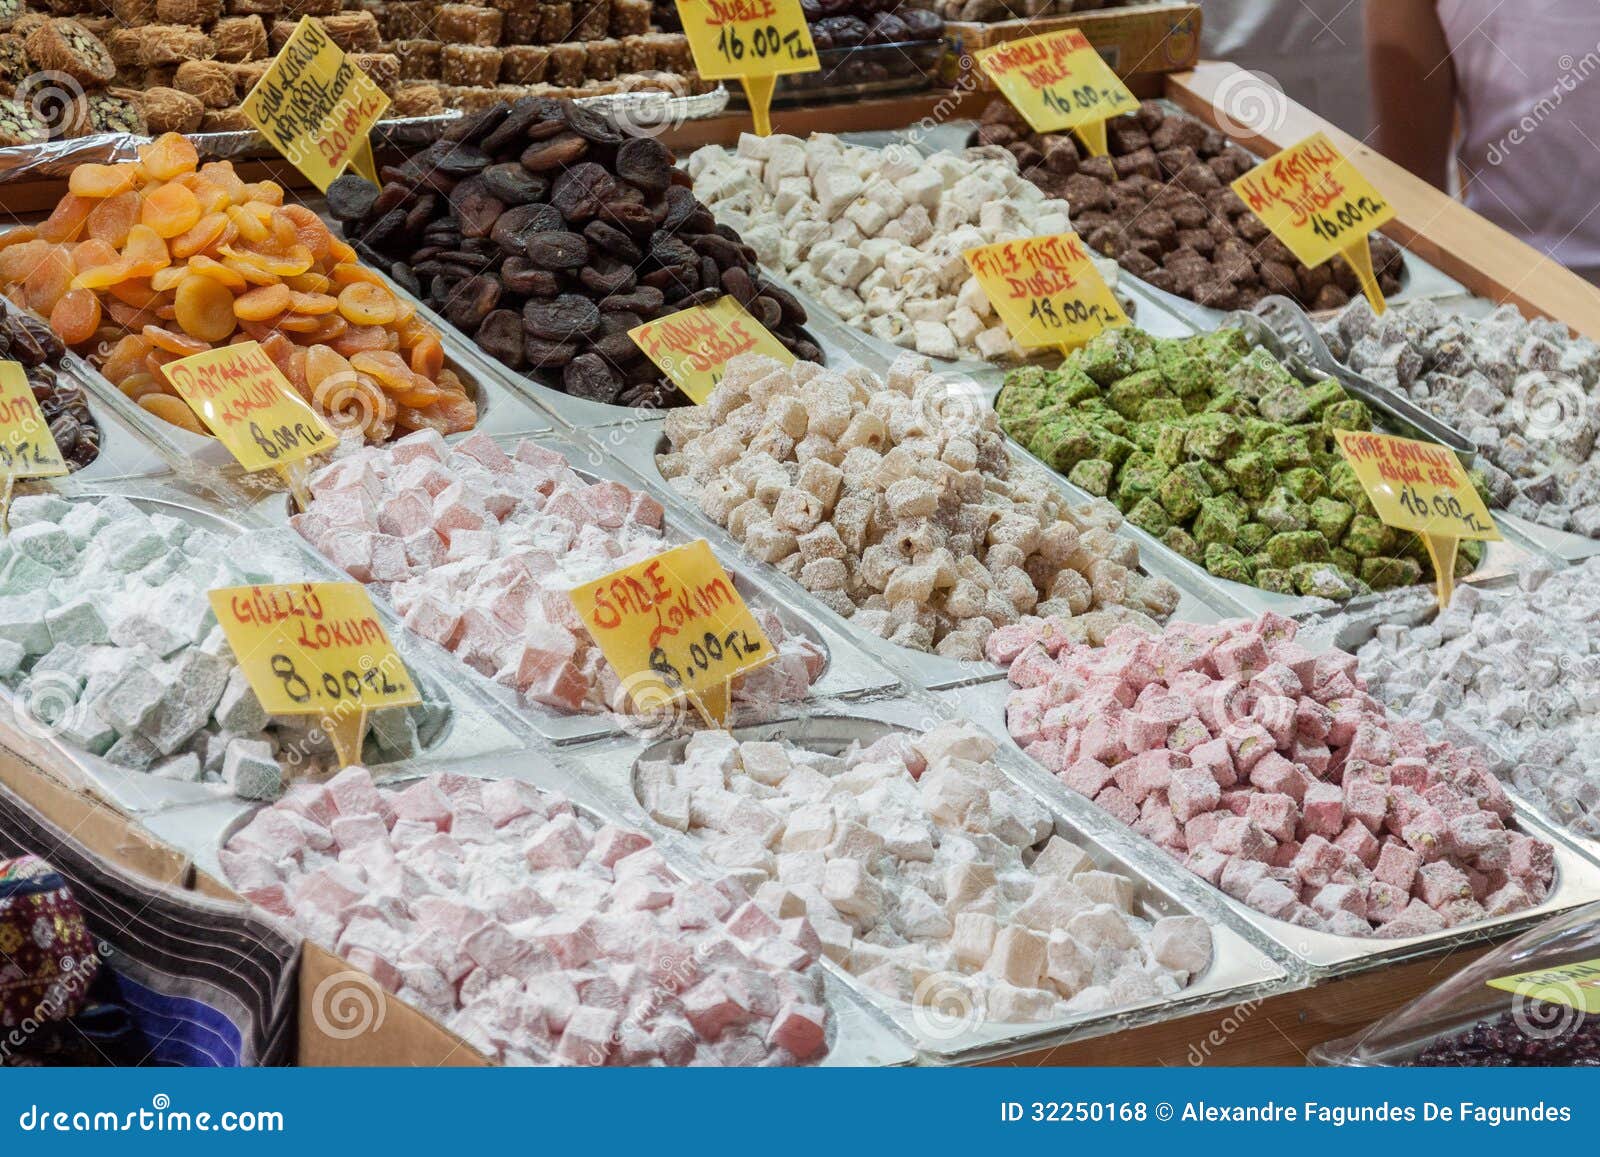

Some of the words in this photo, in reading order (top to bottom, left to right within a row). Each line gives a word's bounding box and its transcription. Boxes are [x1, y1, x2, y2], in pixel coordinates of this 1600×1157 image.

[1281, 171, 1344, 227] DUBLE
[1006, 266, 1078, 298] DUBLE
[231, 583, 323, 627] GÜLLÜ
[593, 560, 673, 629] SADE
[298, 617, 387, 650] LOKUM
